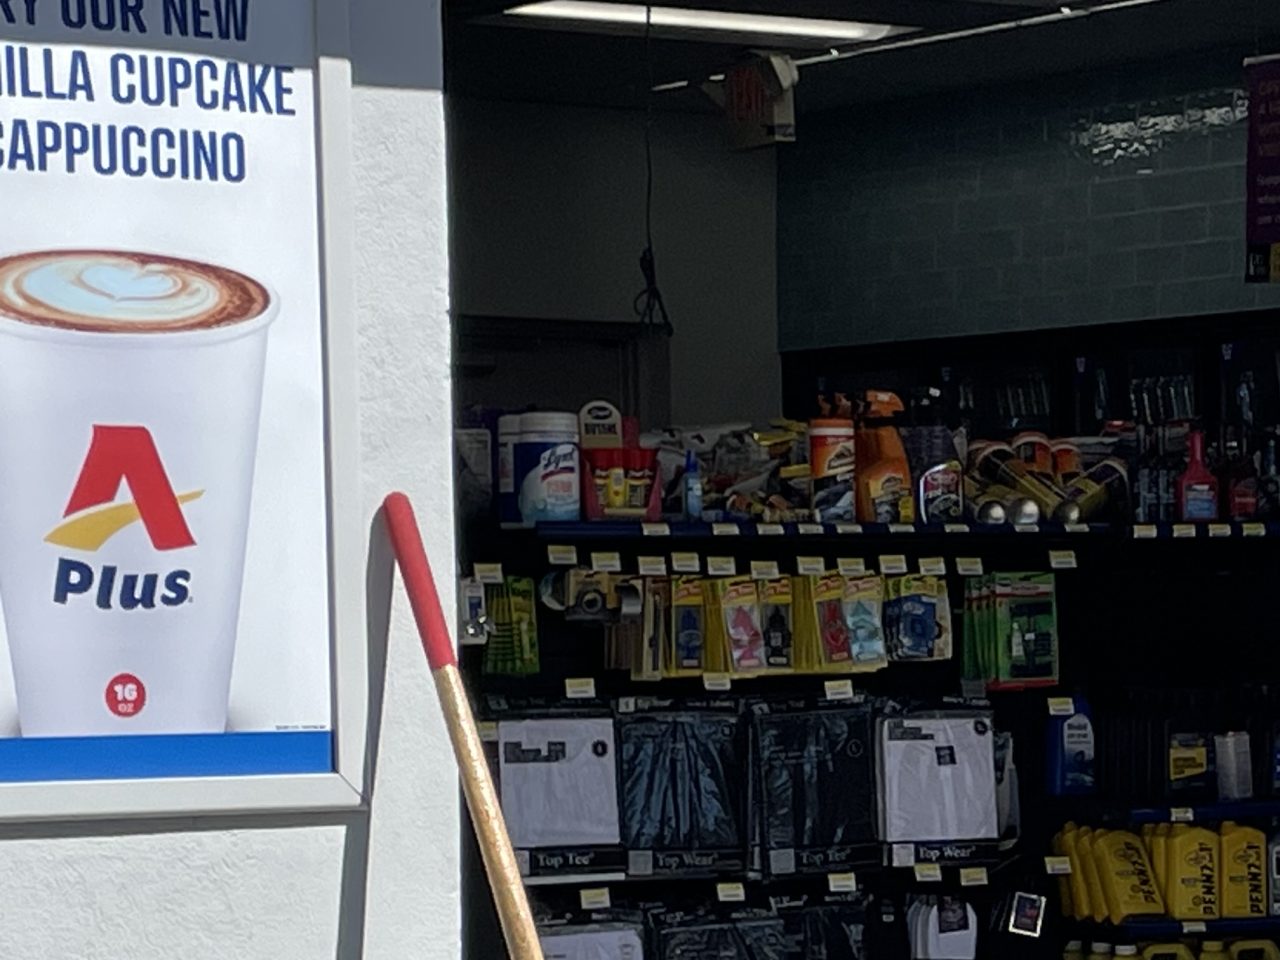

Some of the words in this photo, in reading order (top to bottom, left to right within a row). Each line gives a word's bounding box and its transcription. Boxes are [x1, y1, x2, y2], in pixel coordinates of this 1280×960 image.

[163, 0, 249, 41] NEW
[0, 45, 94, 101] ILLA
[110, 53, 296, 116] CUPCAKE
[0, 118, 246, 183] APPUCCINO
[53, 557, 192, 610] Plus
[113, 683, 138, 701] 16
